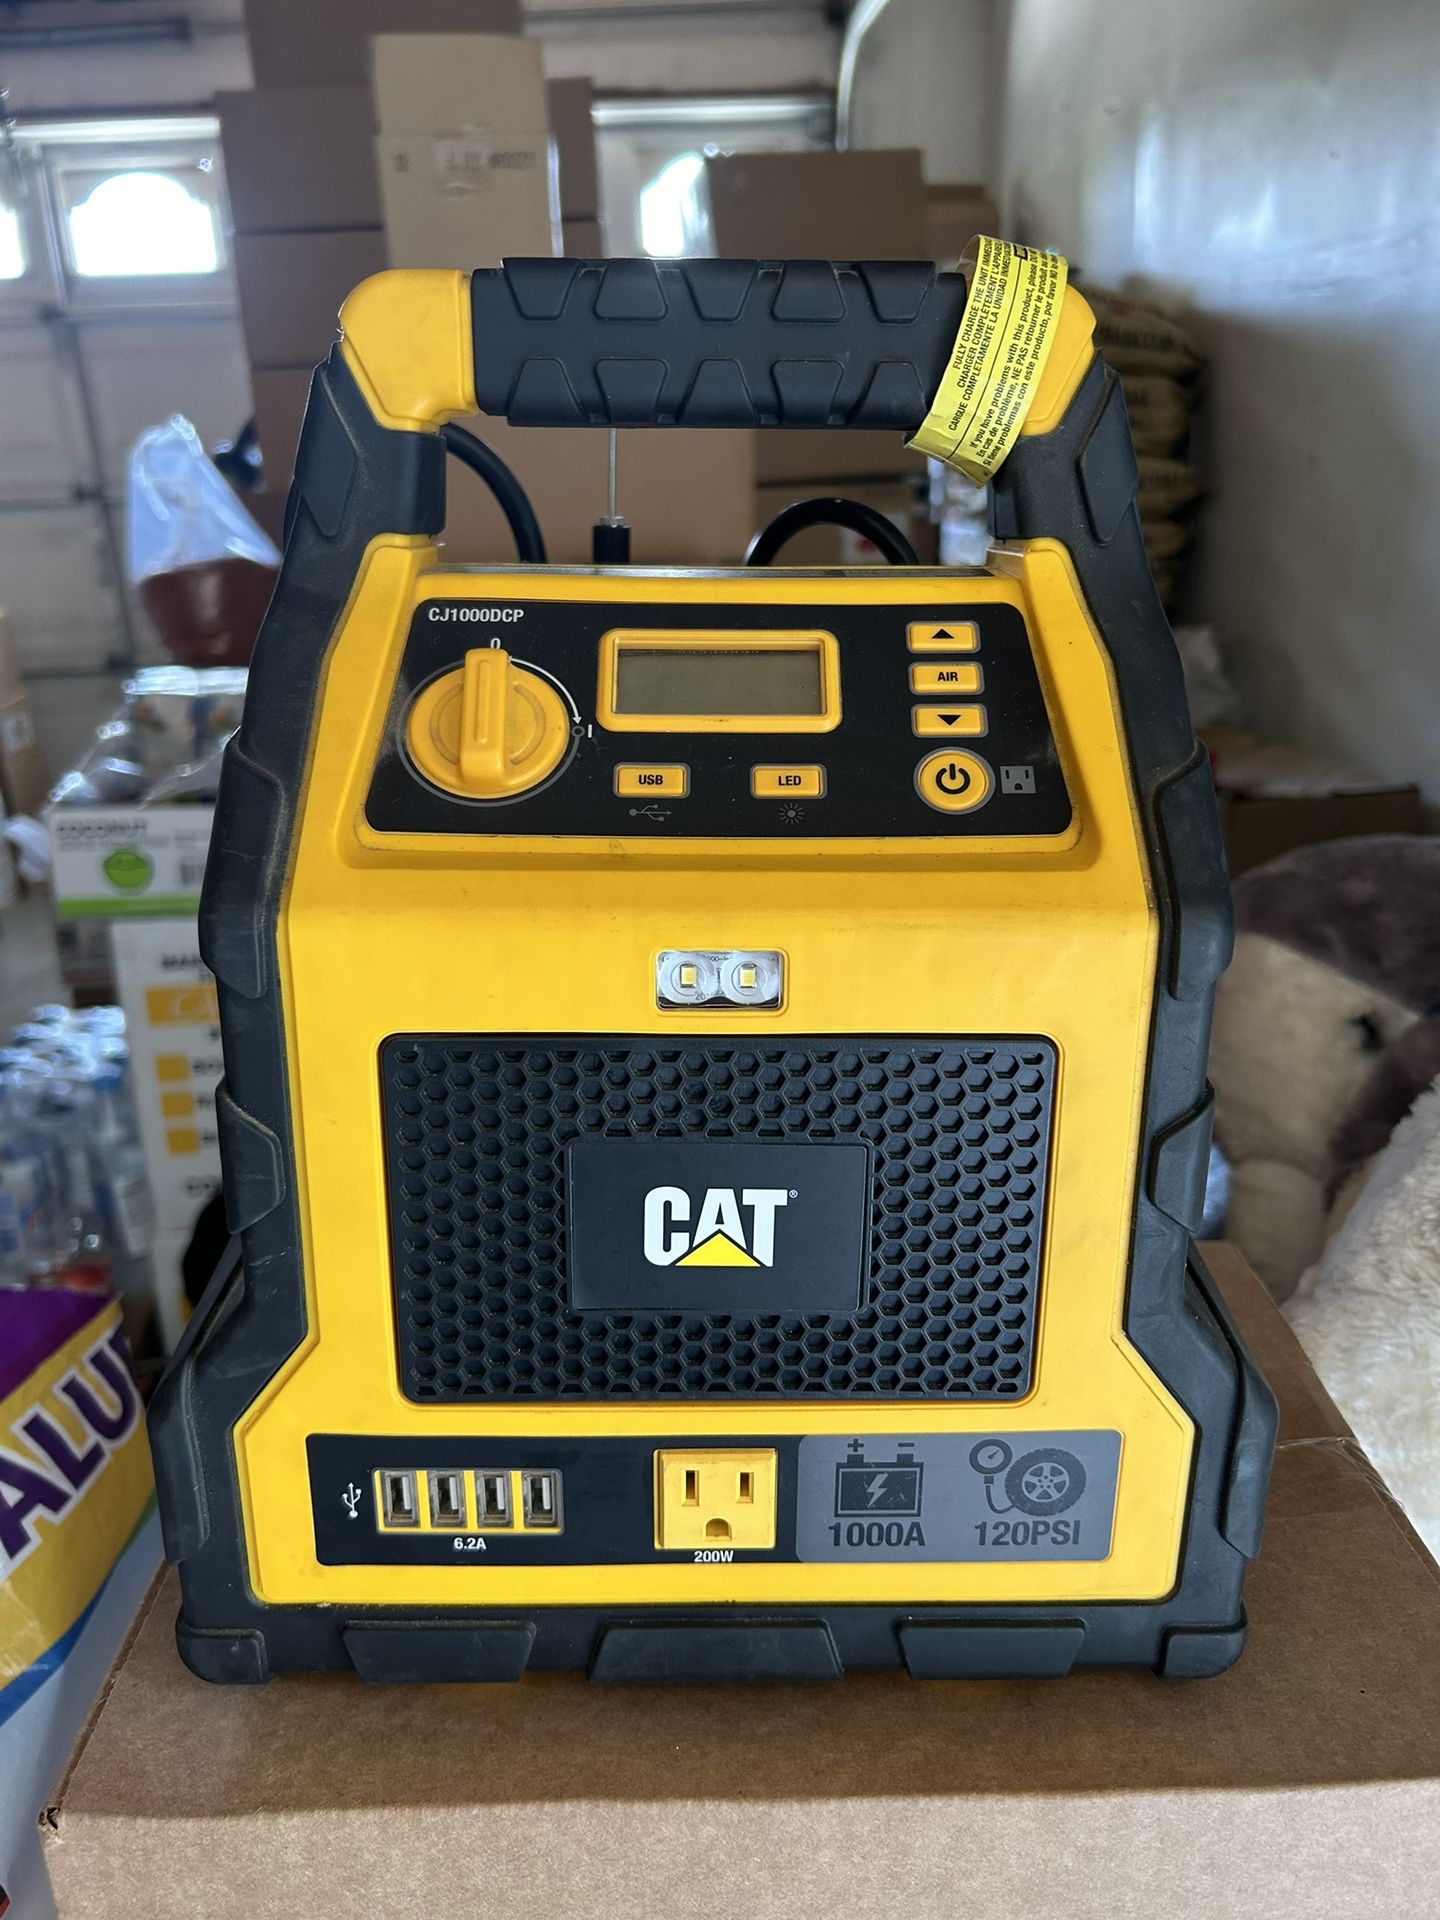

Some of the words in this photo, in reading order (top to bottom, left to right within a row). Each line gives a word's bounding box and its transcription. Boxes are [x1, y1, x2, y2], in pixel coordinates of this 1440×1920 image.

[977, 267, 989, 286] UNIT
[1027, 262, 1038, 287] please
[1038, 267, 1048, 295] produit
[1049, 268, 1059, 281] NO
[973, 286, 985, 304] THE
[993, 278, 1008, 310] UNIDAD
[1034, 294, 1044, 304] le
[1046, 279, 1057, 301] favor
[1020, 287, 1036, 323] product,
[1044, 300, 1054, 316] por
[961, 305, 980, 342] CHARGE
[988, 311, 999, 324] LA
[1024, 304, 1043, 346] retourner
[1013, 323, 1025, 341] this
[1031, 316, 1051, 361] producto,
[952, 343, 967, 371] FULLY
[962, 324, 996, 401] COMPLETAMENTE
[1006, 342, 1019, 364] with
[1016, 346, 1029, 366] PAS
[956, 346, 978, 389] CHARGER
[1011, 366, 1023, 381] NE
[1024, 361, 1036, 381] este
[991, 365, 1012, 409] problems
[1017, 382, 1030, 400] con
[948, 401, 968, 431] CARGUE
[980, 408, 996, 429] have
[997, 401, 1022, 447] problemas
[974, 429, 986, 444] you
[989, 426, 999, 438] de
[968, 441, 979, 449] If
[975, 448, 987, 458] En
[982, 437, 994, 450] cas
[987, 445, 1001, 461] tiene
[983, 458, 993, 467] Si
[428, 607, 525, 623] CJ1000DCP
[937, 671, 959, 682] AIR
[637, 774, 664, 786] USB
[777, 775, 802, 786] LED
[643, 1186, 788, 1267] CAT
[828, 1522, 926, 1546] 1000A
[974, 1520, 1081, 1546] 120PSI
[453, 1537, 487, 1550] 6.2A
[694, 1550, 734, 1563] 200W
